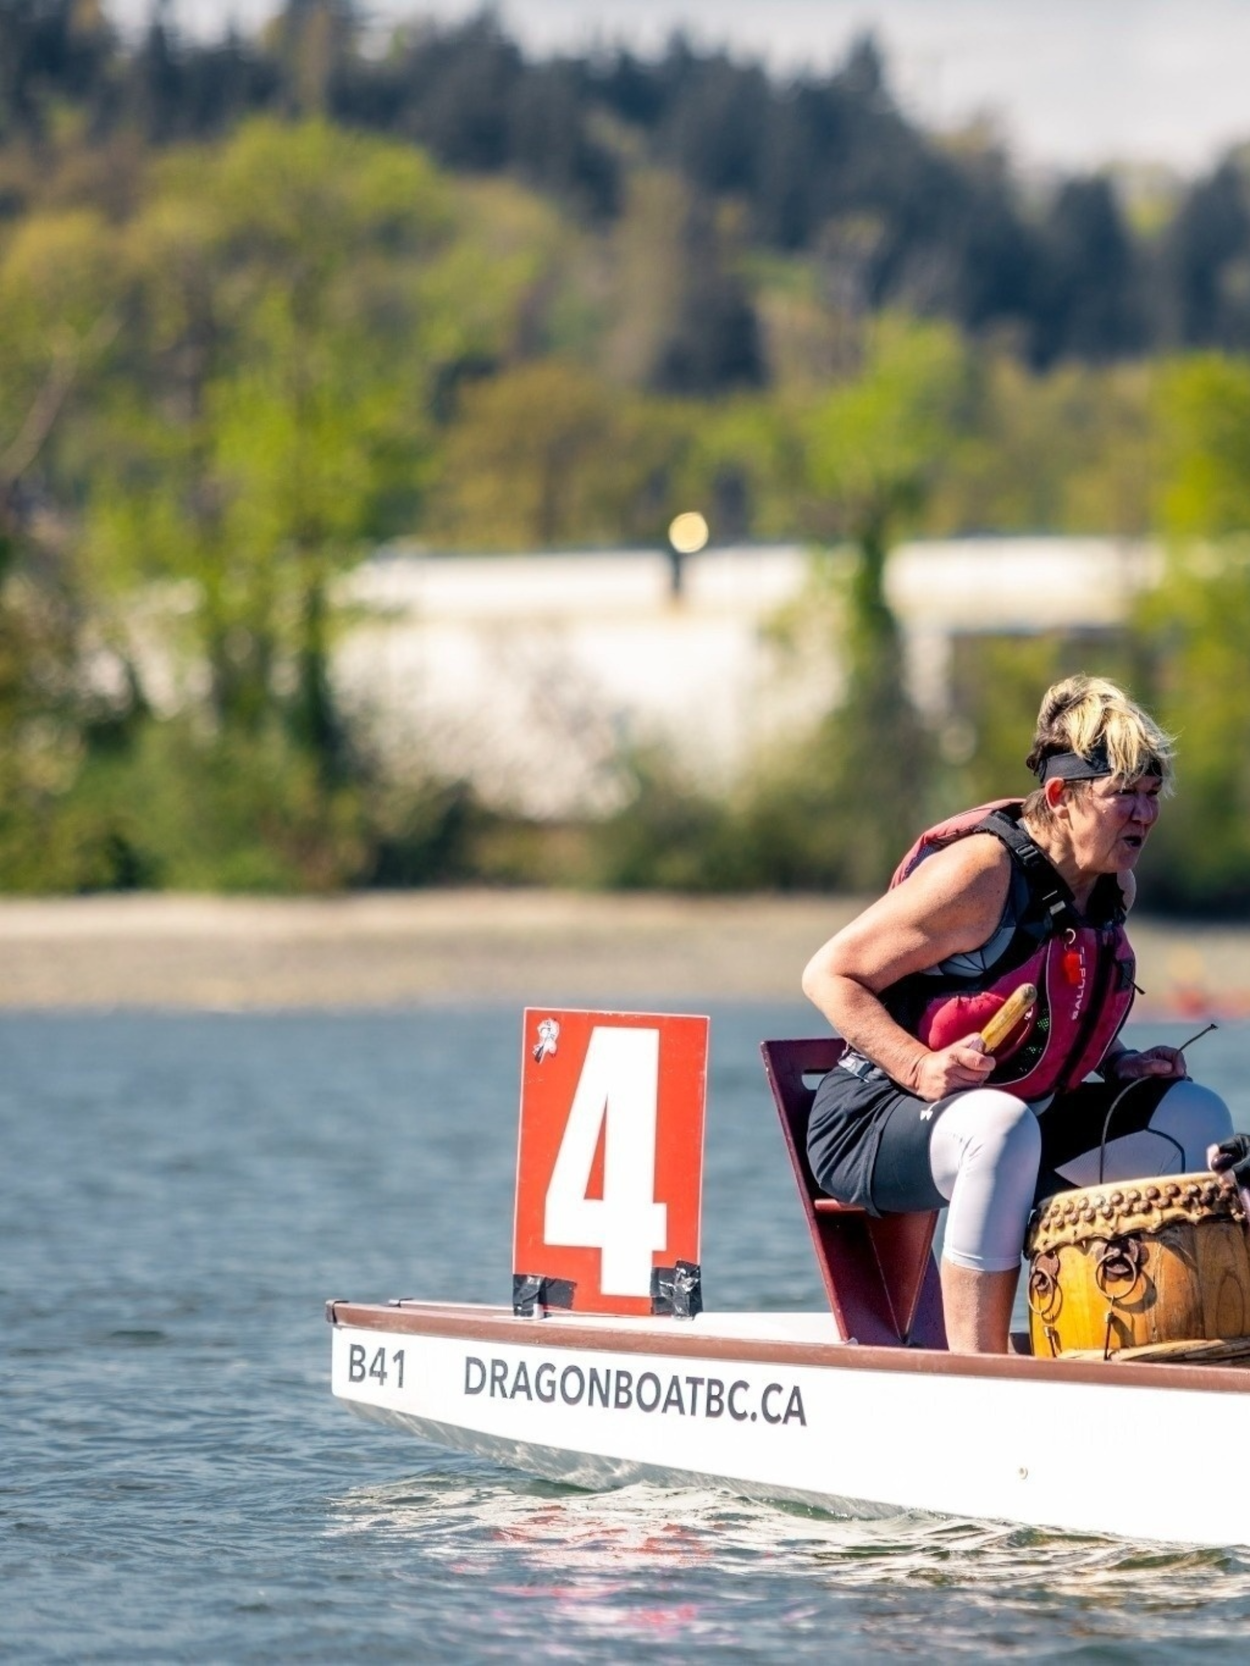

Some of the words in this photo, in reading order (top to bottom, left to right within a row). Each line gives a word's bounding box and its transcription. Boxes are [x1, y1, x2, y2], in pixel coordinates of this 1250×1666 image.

[544, 1026, 667, 1297] 4
[348, 1343, 405, 1389] B41
[463, 1355, 808, 1427] DRAGONBOATBC.CA
